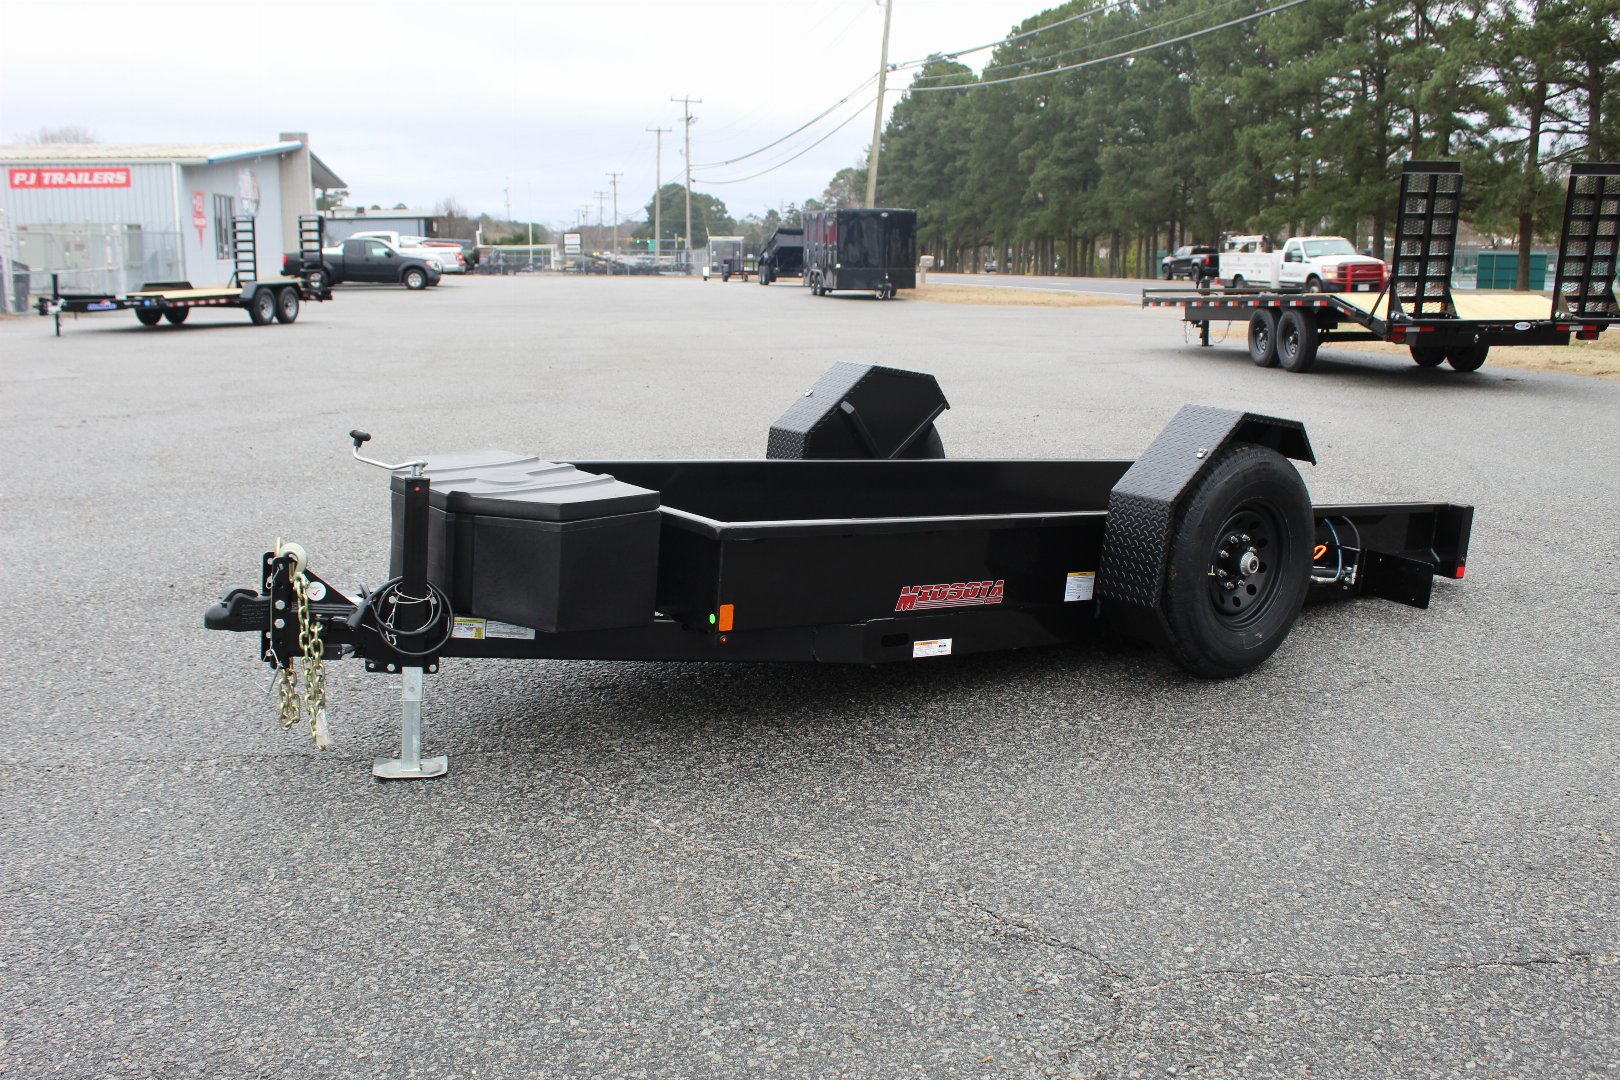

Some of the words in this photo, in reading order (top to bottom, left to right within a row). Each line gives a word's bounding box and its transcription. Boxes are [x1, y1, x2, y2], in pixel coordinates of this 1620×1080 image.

[14, 172, 37, 185] PJ
[41, 171, 127, 185] TRAILERS
[895, 580, 1004, 612] MIDSOTA
